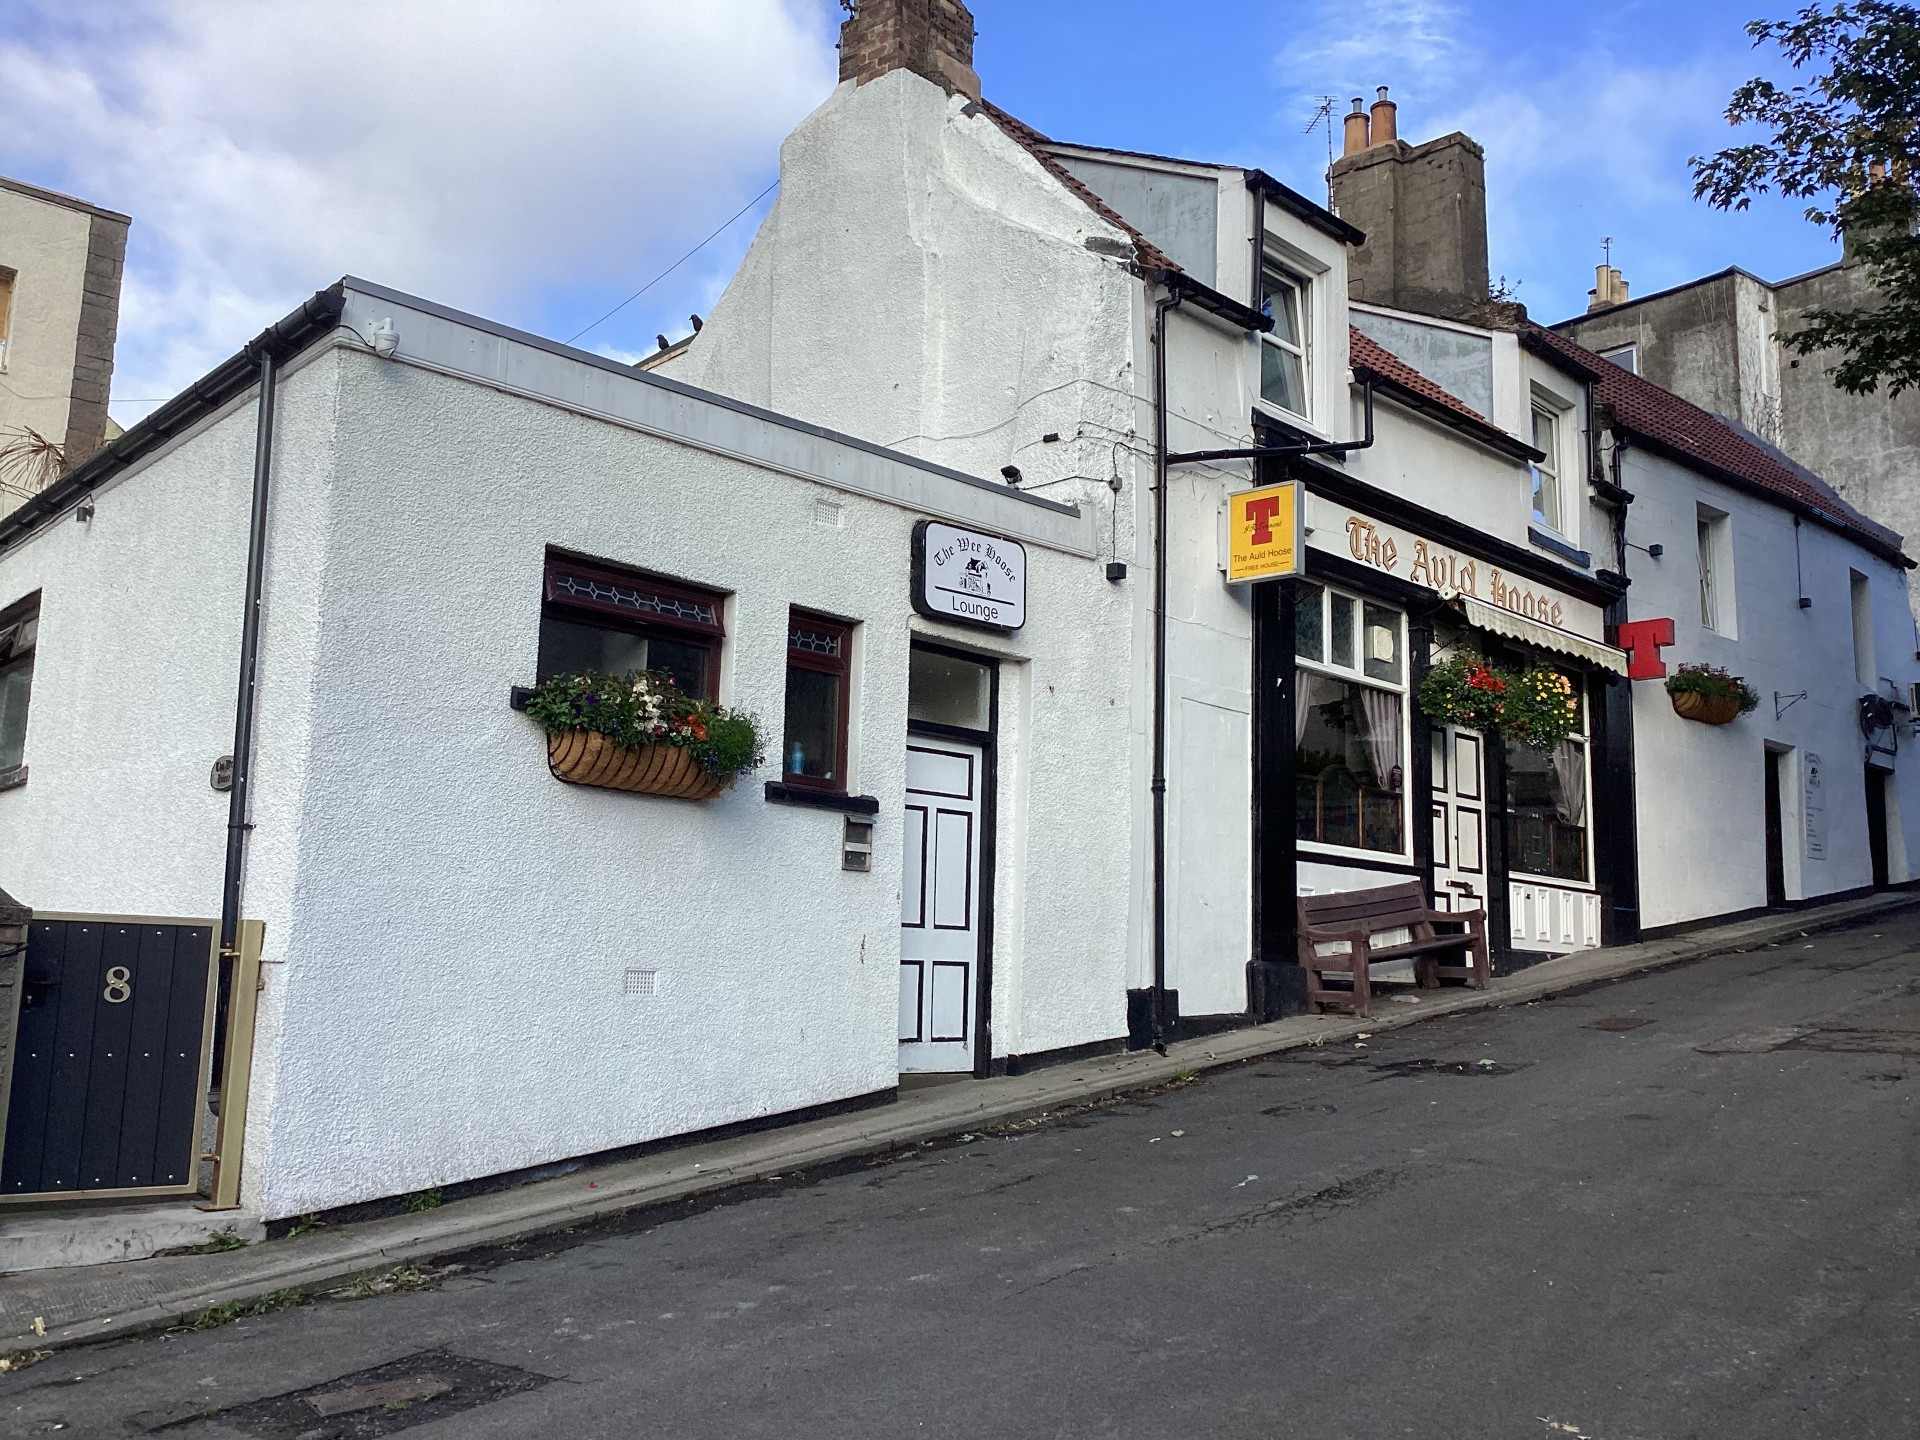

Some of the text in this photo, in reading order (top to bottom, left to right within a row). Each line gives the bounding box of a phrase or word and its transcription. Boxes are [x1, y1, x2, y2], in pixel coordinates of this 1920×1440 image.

[1246, 496, 1279, 546] T
[933, 537, 1016, 583] The Wee Hoose
[1233, 548, 1291, 563] The Auld Hoose
[1345, 516, 1563, 627] The Auld Hoose
[952, 595, 999, 621] Lounge
[1617, 617, 1675, 681] T
[103, 965, 131, 1003] 8
